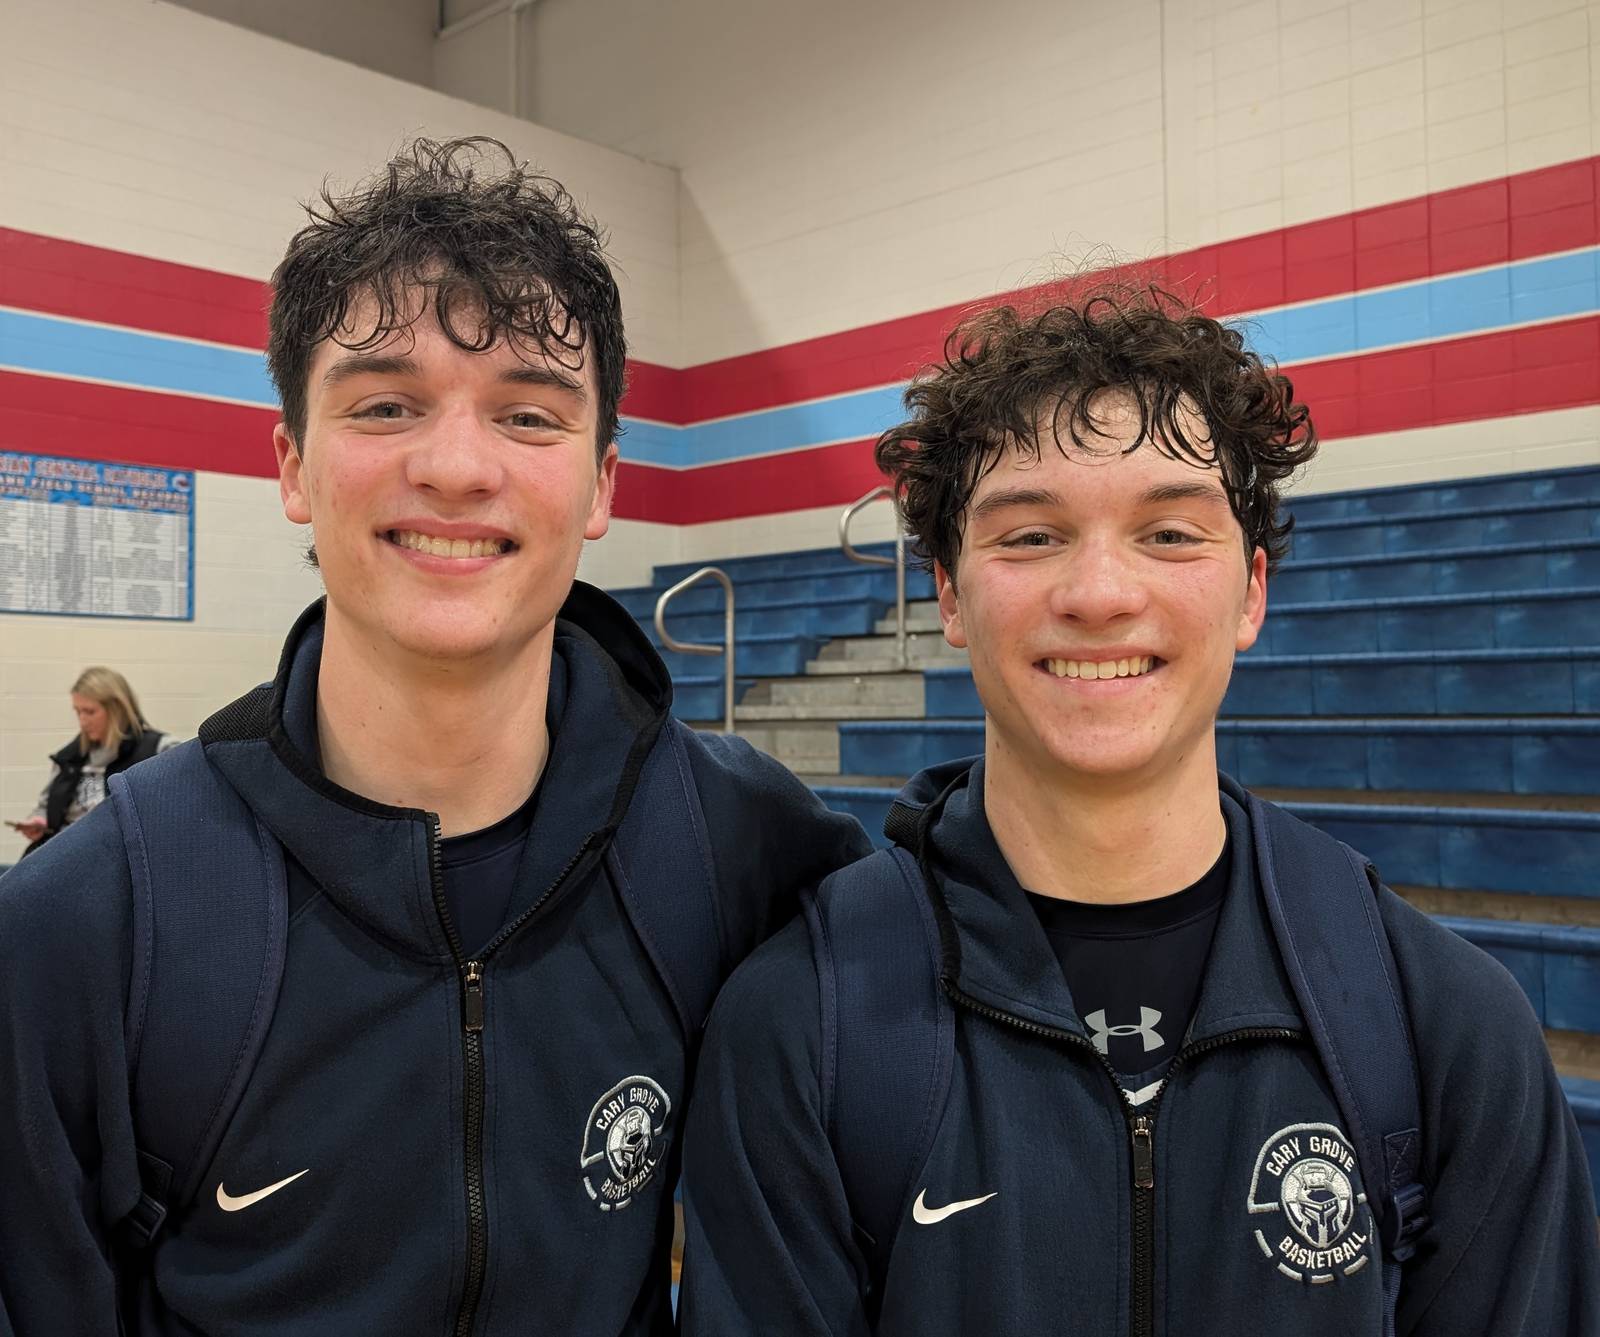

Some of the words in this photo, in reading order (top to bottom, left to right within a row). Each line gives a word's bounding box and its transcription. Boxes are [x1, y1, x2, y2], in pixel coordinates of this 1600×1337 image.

[596, 1092, 626, 1131] CARY
[629, 1087, 660, 1114] GROVE
[1265, 1137, 1302, 1176] CARY
[1310, 1136, 1356, 1172] GROVE
[600, 1158, 657, 1200] BASKETBALL
[1278, 1231, 1367, 1270] BASKETBALL
